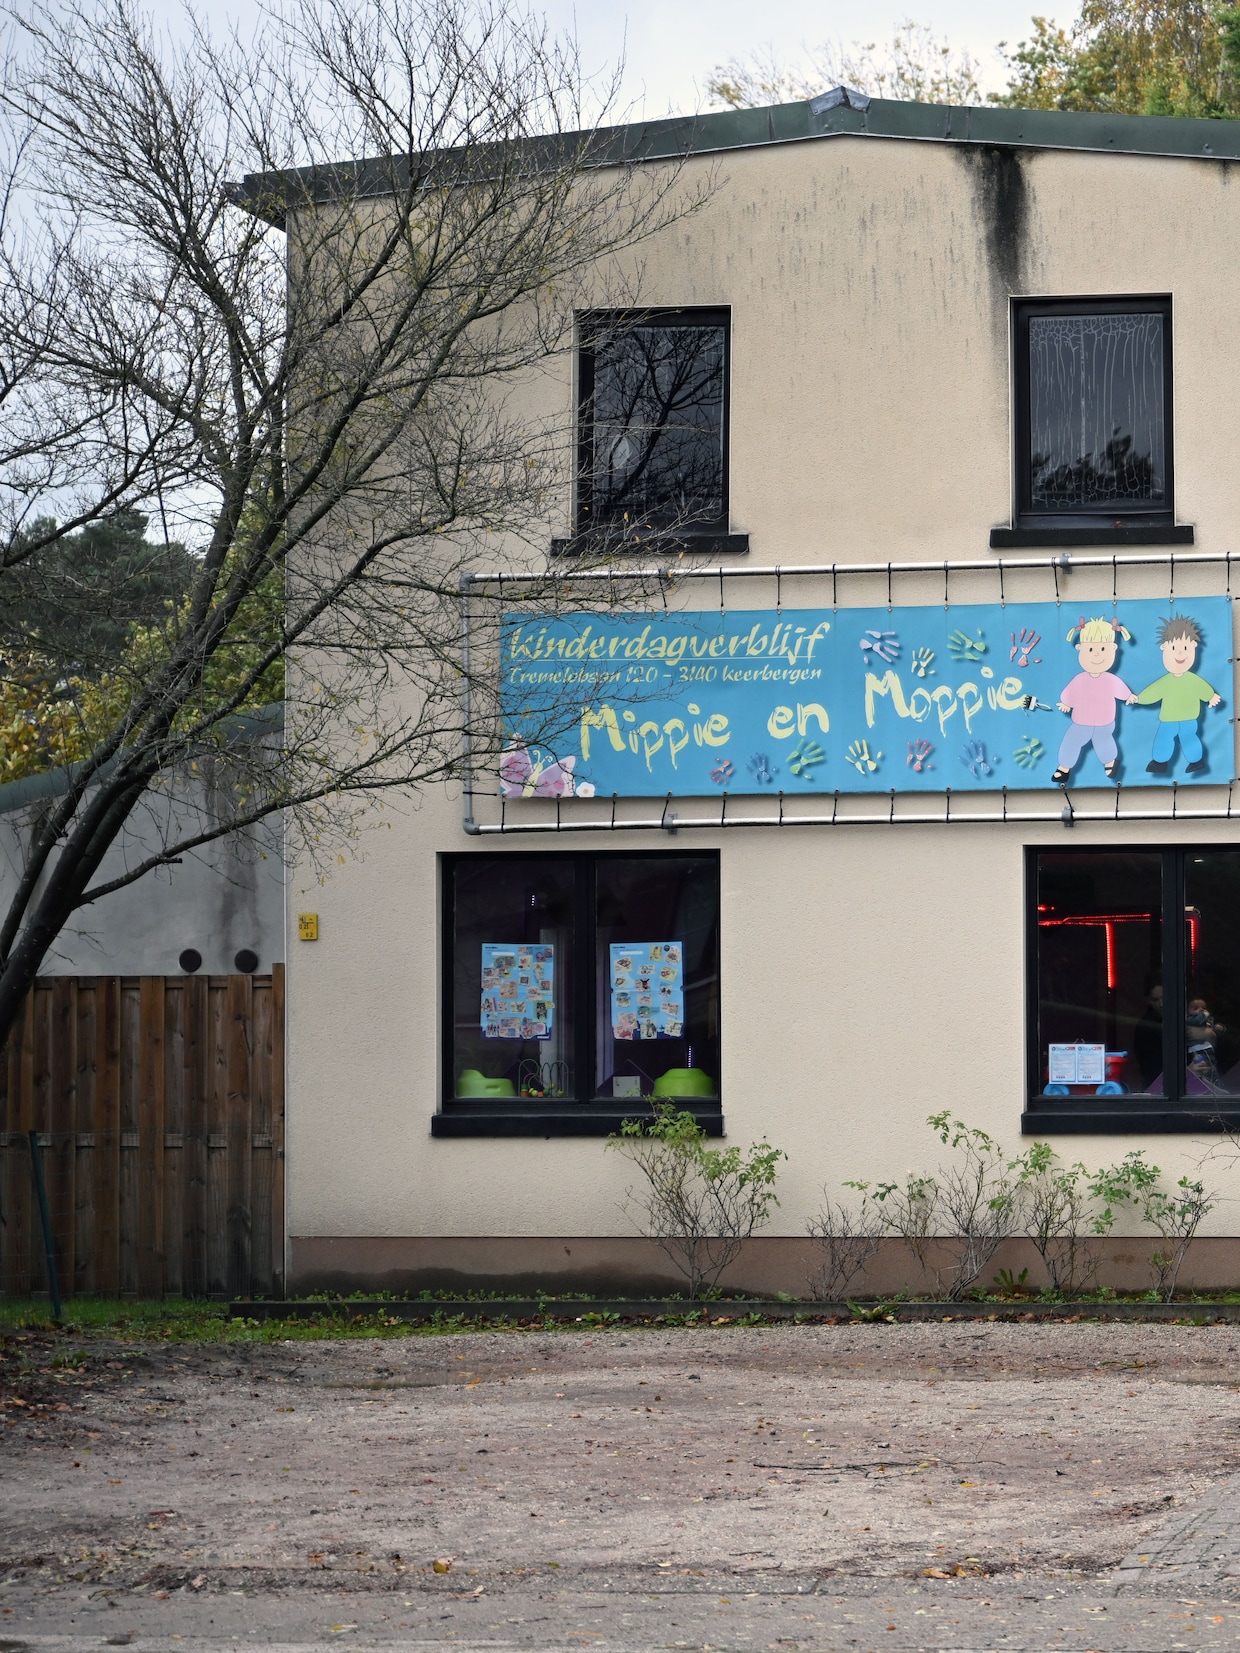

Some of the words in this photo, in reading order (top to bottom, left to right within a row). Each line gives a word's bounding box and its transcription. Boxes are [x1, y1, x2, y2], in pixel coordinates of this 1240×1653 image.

[625, 665, 658, 684] 120
[678, 665, 718, 683] 3140
[579, 702, 732, 774] Mippie
[767, 703, 830, 739] en
[865, 666, 1027, 738] Moppie
